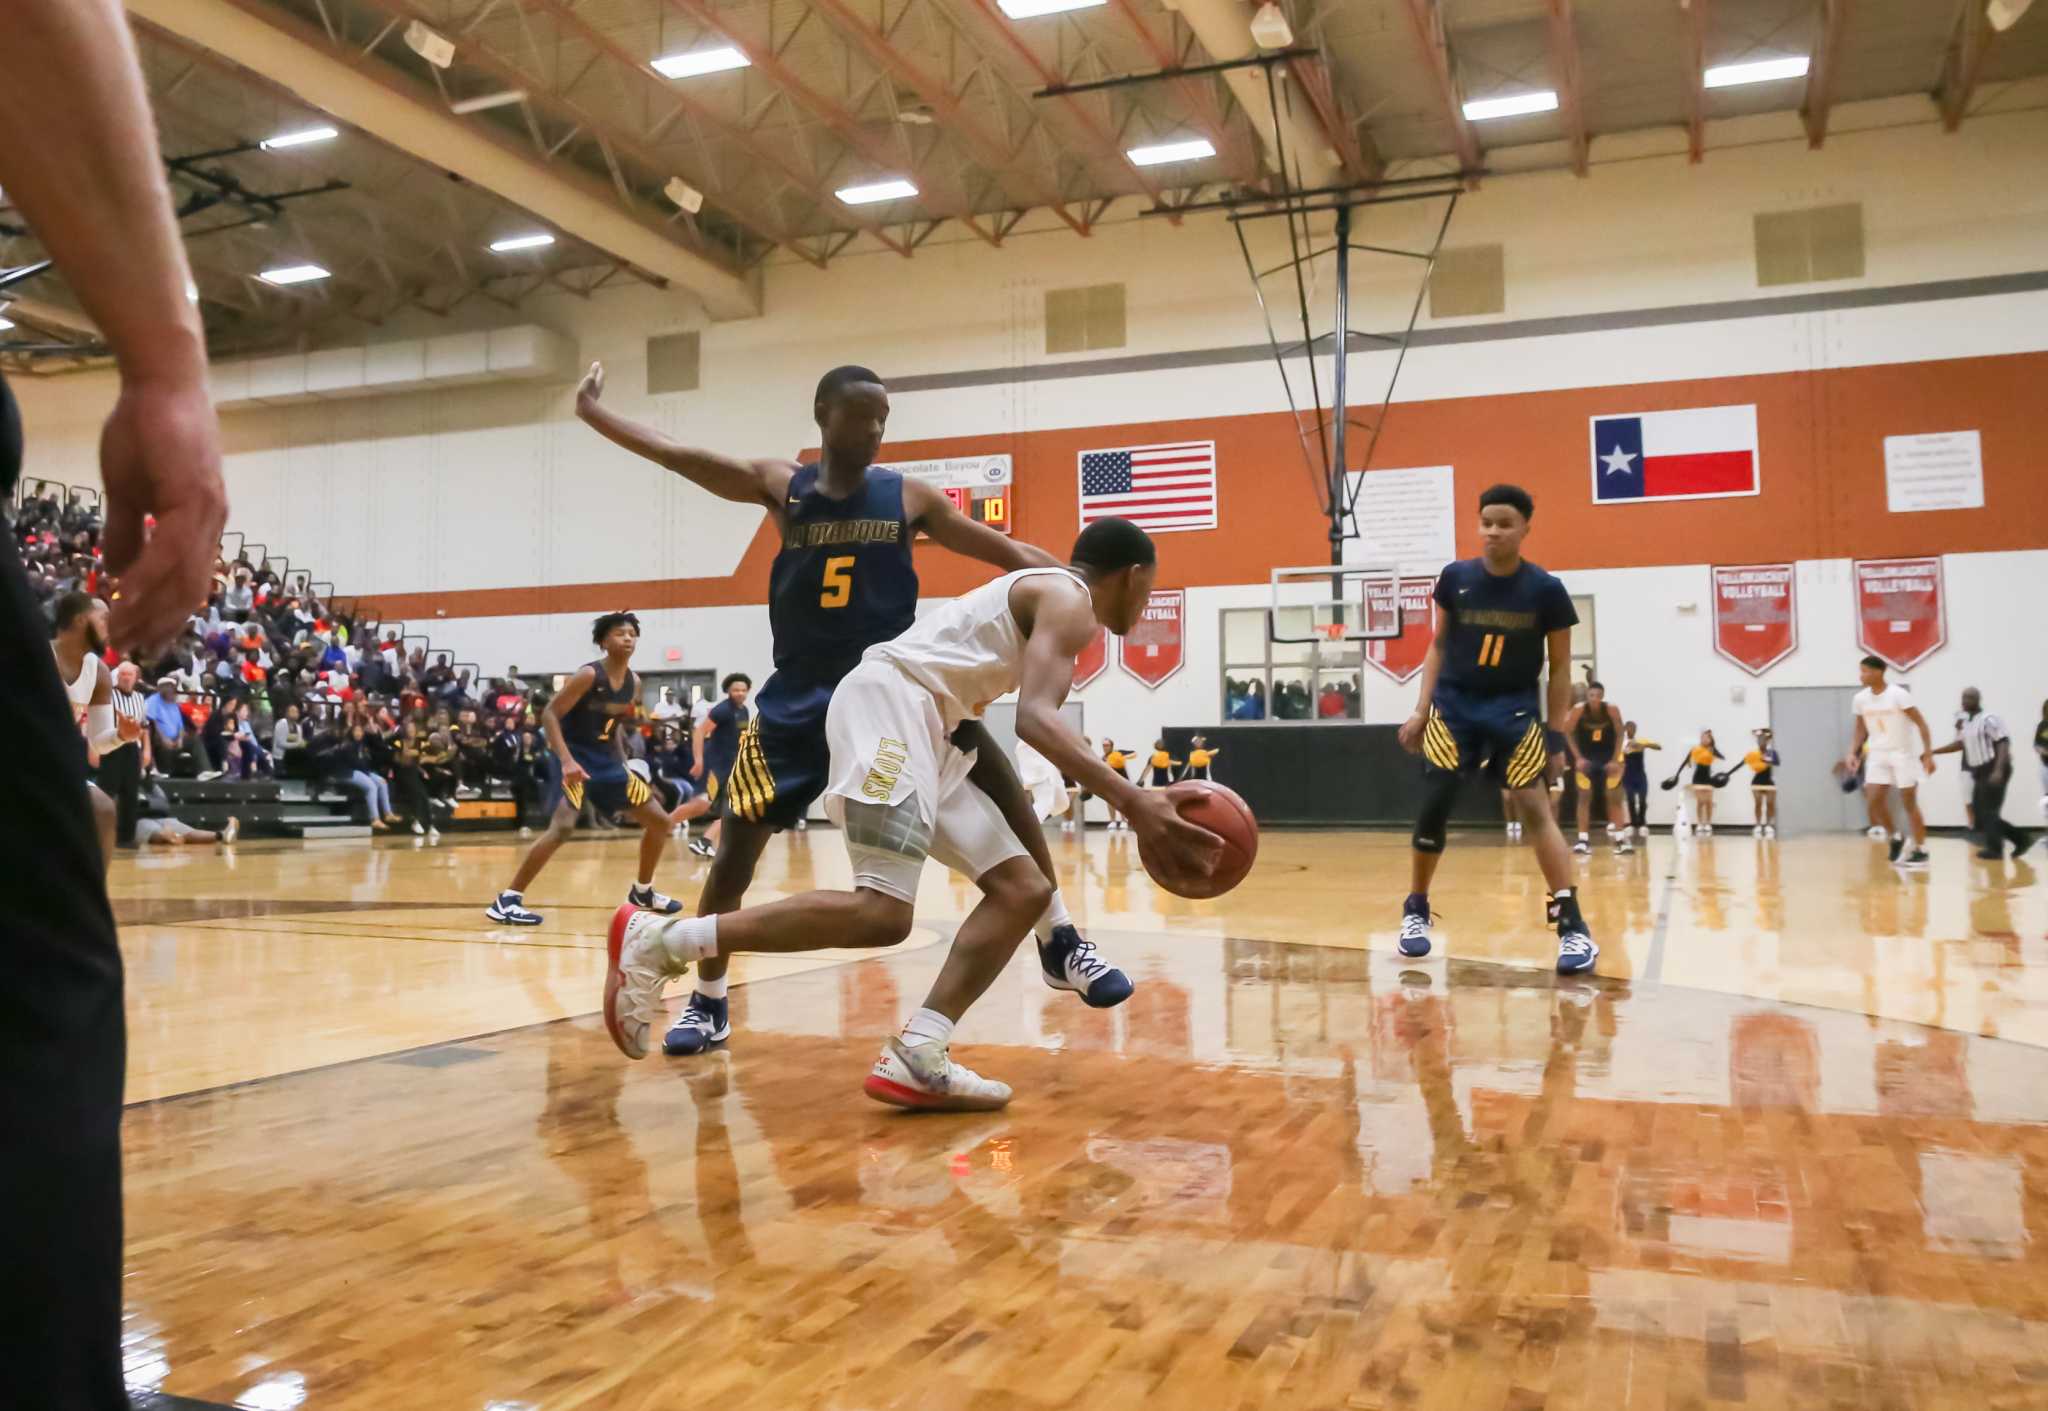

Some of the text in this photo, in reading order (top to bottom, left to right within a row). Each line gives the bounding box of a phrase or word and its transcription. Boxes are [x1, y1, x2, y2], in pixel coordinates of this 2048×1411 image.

[944, 462, 980, 472] Bayou
[984, 498, 1004, 522] 10
[820, 556, 856, 608] 5
[1477, 634, 1505, 667] 11
[863, 737, 908, 801] LIONS
